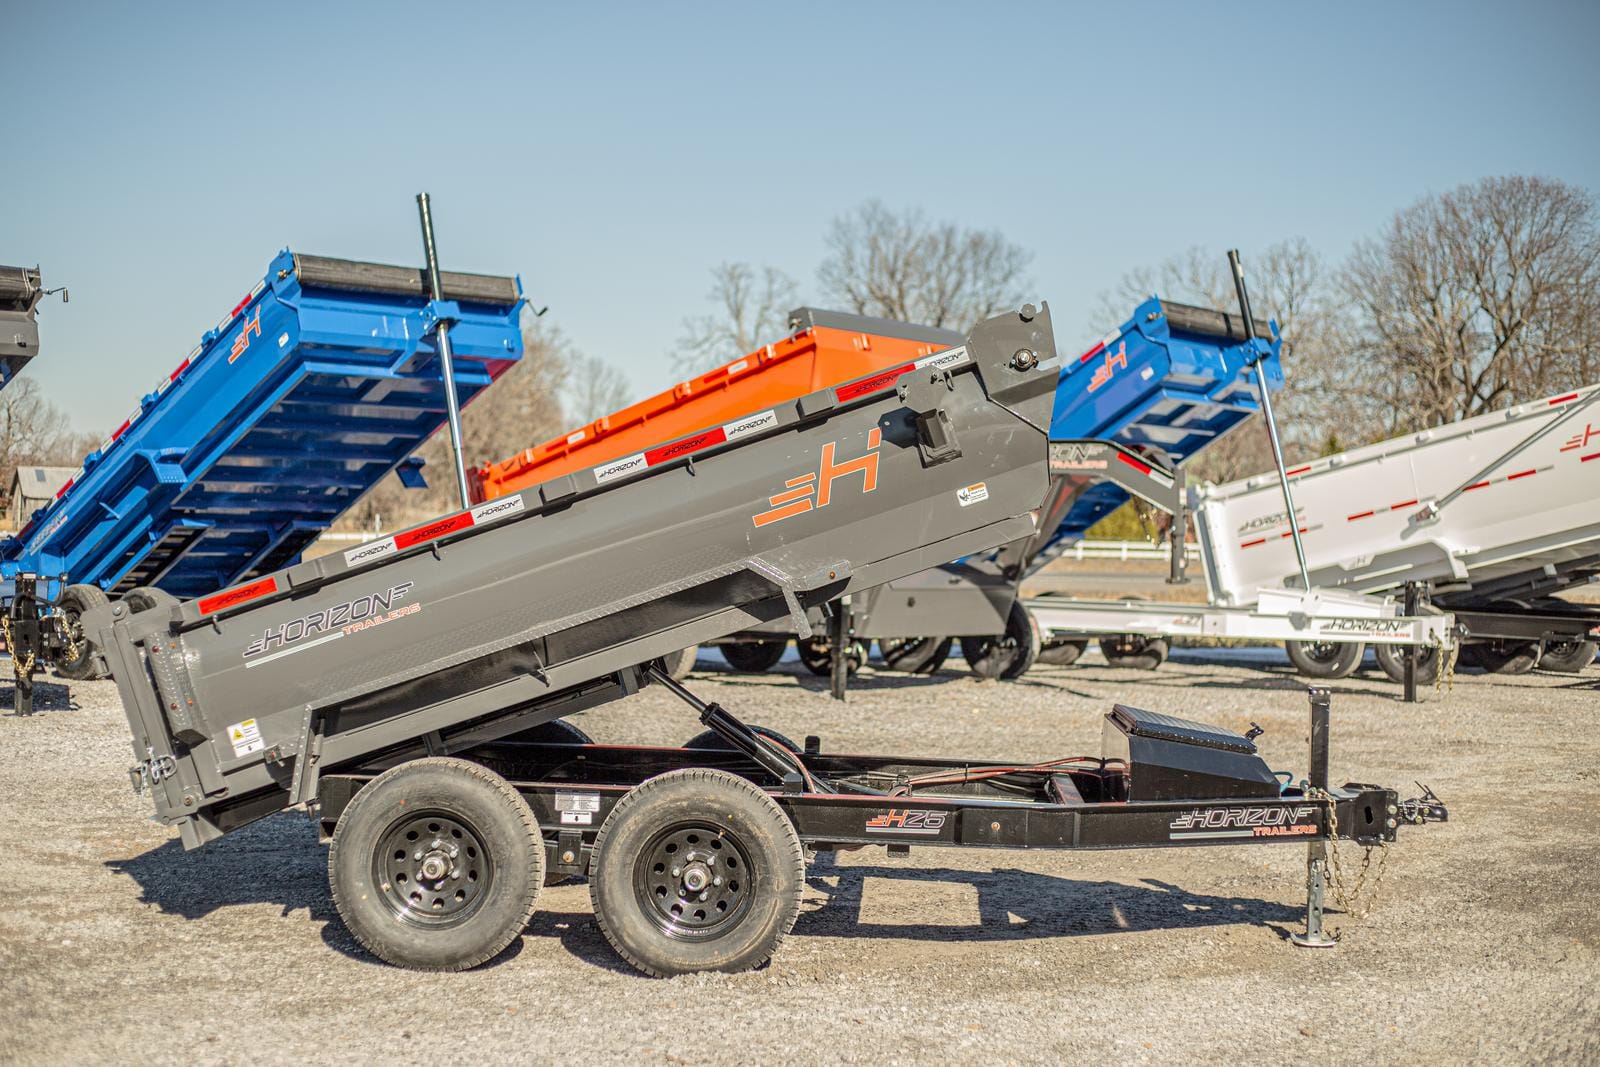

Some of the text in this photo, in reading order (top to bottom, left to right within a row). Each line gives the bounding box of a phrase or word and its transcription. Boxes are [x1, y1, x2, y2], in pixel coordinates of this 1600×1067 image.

[731, 415, 771, 435] HORIZON
[665, 437, 706, 456] HORIZON
[601, 459, 641, 477] HORIZON
[479, 499, 519, 518] HORIZON
[415, 521, 455, 540] HORIZON
[352, 543, 391, 561] HORIZON
[261, 586, 396, 651] HORIZON
[342, 602, 422, 635] TRAILERS
[1328, 618, 1402, 632] HORIZON
[1186, 804, 1305, 829] HORIZON
[1253, 825, 1318, 837] TRAILERS
